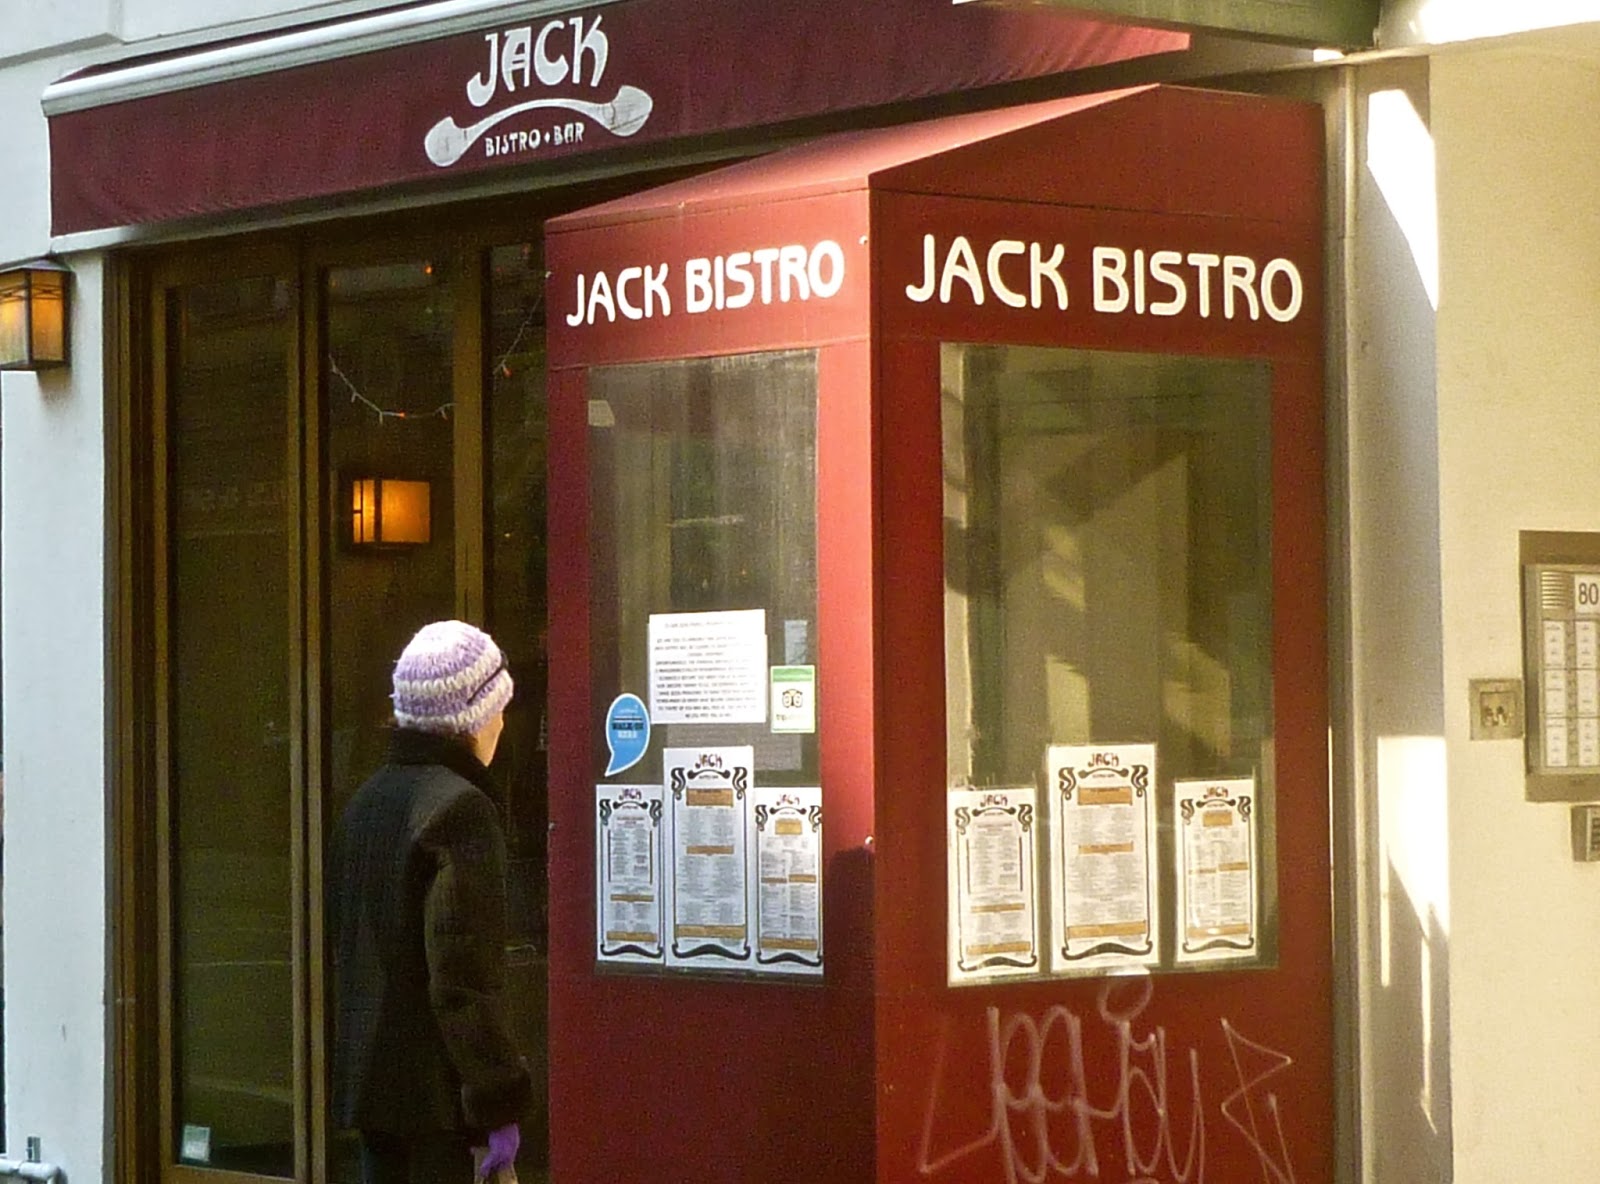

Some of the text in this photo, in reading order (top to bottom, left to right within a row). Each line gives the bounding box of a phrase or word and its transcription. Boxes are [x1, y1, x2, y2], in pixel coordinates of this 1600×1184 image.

[466, 15, 609, 107] JACK
[485, 121, 586, 157] BISTRO BAR
[566, 240, 845, 327] JACK BISTRO
[905, 233, 1303, 323] JACK BISTRO
[1578, 583, 1599, 605] 80
